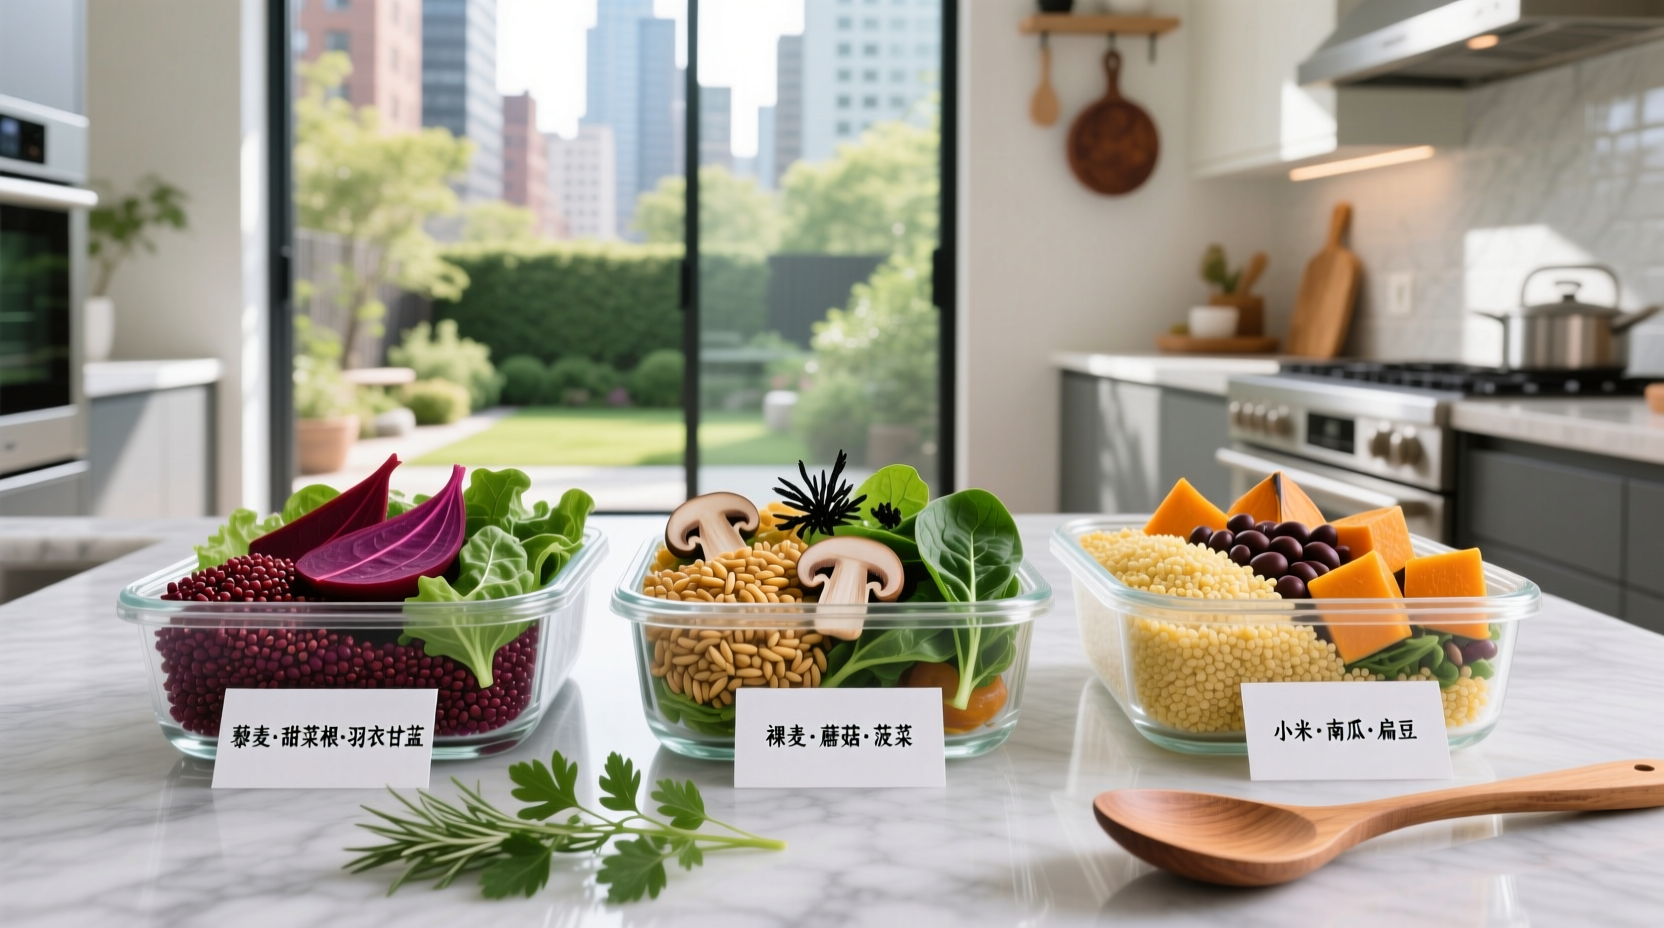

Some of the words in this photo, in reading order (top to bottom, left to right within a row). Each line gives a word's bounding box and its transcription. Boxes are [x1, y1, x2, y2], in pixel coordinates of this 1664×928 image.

[765, 723, 913, 748] 裸麦·蘑菇·菠菜
[1274, 718, 1418, 742] 小米·南瓜·扁豆
